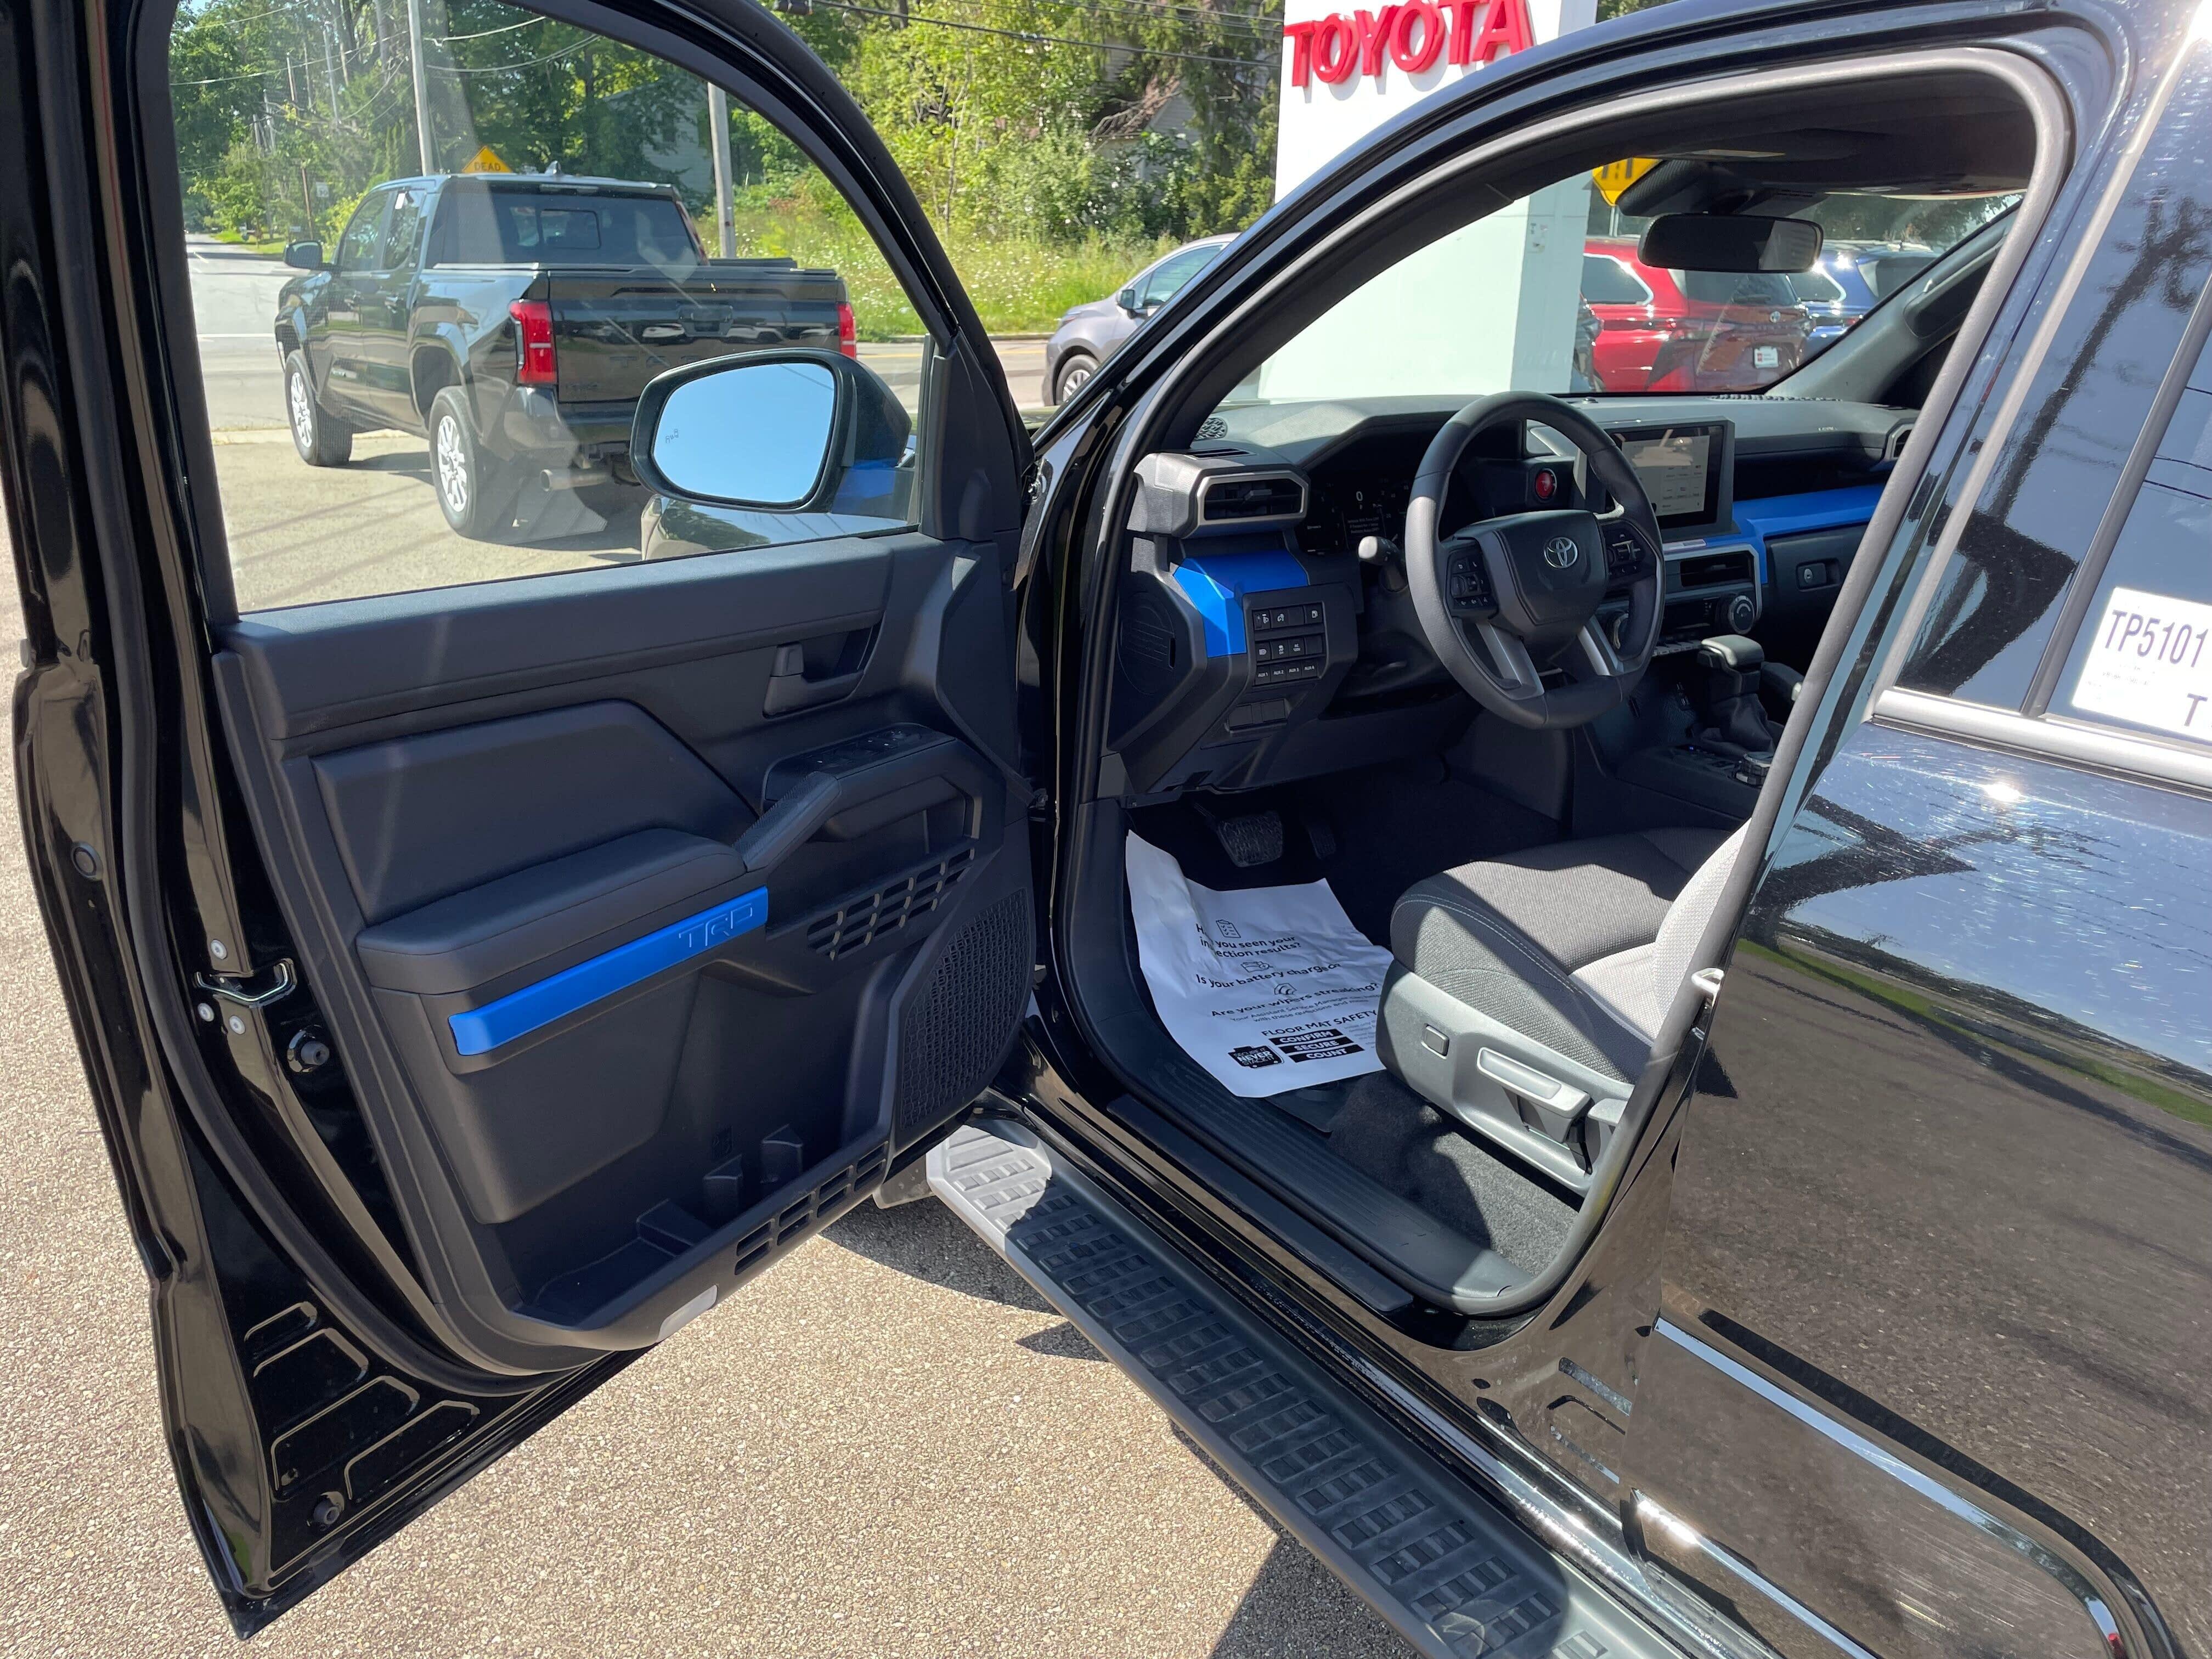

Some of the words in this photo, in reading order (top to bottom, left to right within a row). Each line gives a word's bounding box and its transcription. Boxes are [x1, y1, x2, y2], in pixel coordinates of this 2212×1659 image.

[1284, 0, 1535, 87] TOYOTA
[474, 162, 500, 171] DEAD
[2105, 610, 2209, 668] TP5101
[1215, 940, 1237, 948] you
[1268, 936, 1295, 946] your
[1256, 941, 1302, 955] results?
[1196, 974, 1206, 984] Is
[1208, 978, 1235, 988] your
[1235, 971, 1284, 985] battery
[1236, 1004, 1266, 1013] your
[1268, 994, 1312, 1006] wipers
[1314, 983, 1379, 996] streaking?
[1251, 1008, 1285, 1018] Assistant
[1286, 1003, 1314, 1012] Service
[1314, 996, 1348, 1007] Manager
[1272, 1012, 1294, 1020] these
[1295, 1005, 1332, 1015] questions
[1261, 1025, 1305, 1036] FLOOR
[1305, 1020, 1332, 1029] MAT
[1333, 1009, 1378, 1025] SAFETY
[1279, 1030, 1334, 1043] CONFIRM
[1294, 1040, 1339, 1051] SECURE
[1237, 1051, 1271, 1062] NEVER
[1306, 1048, 1347, 1059] COUNT
